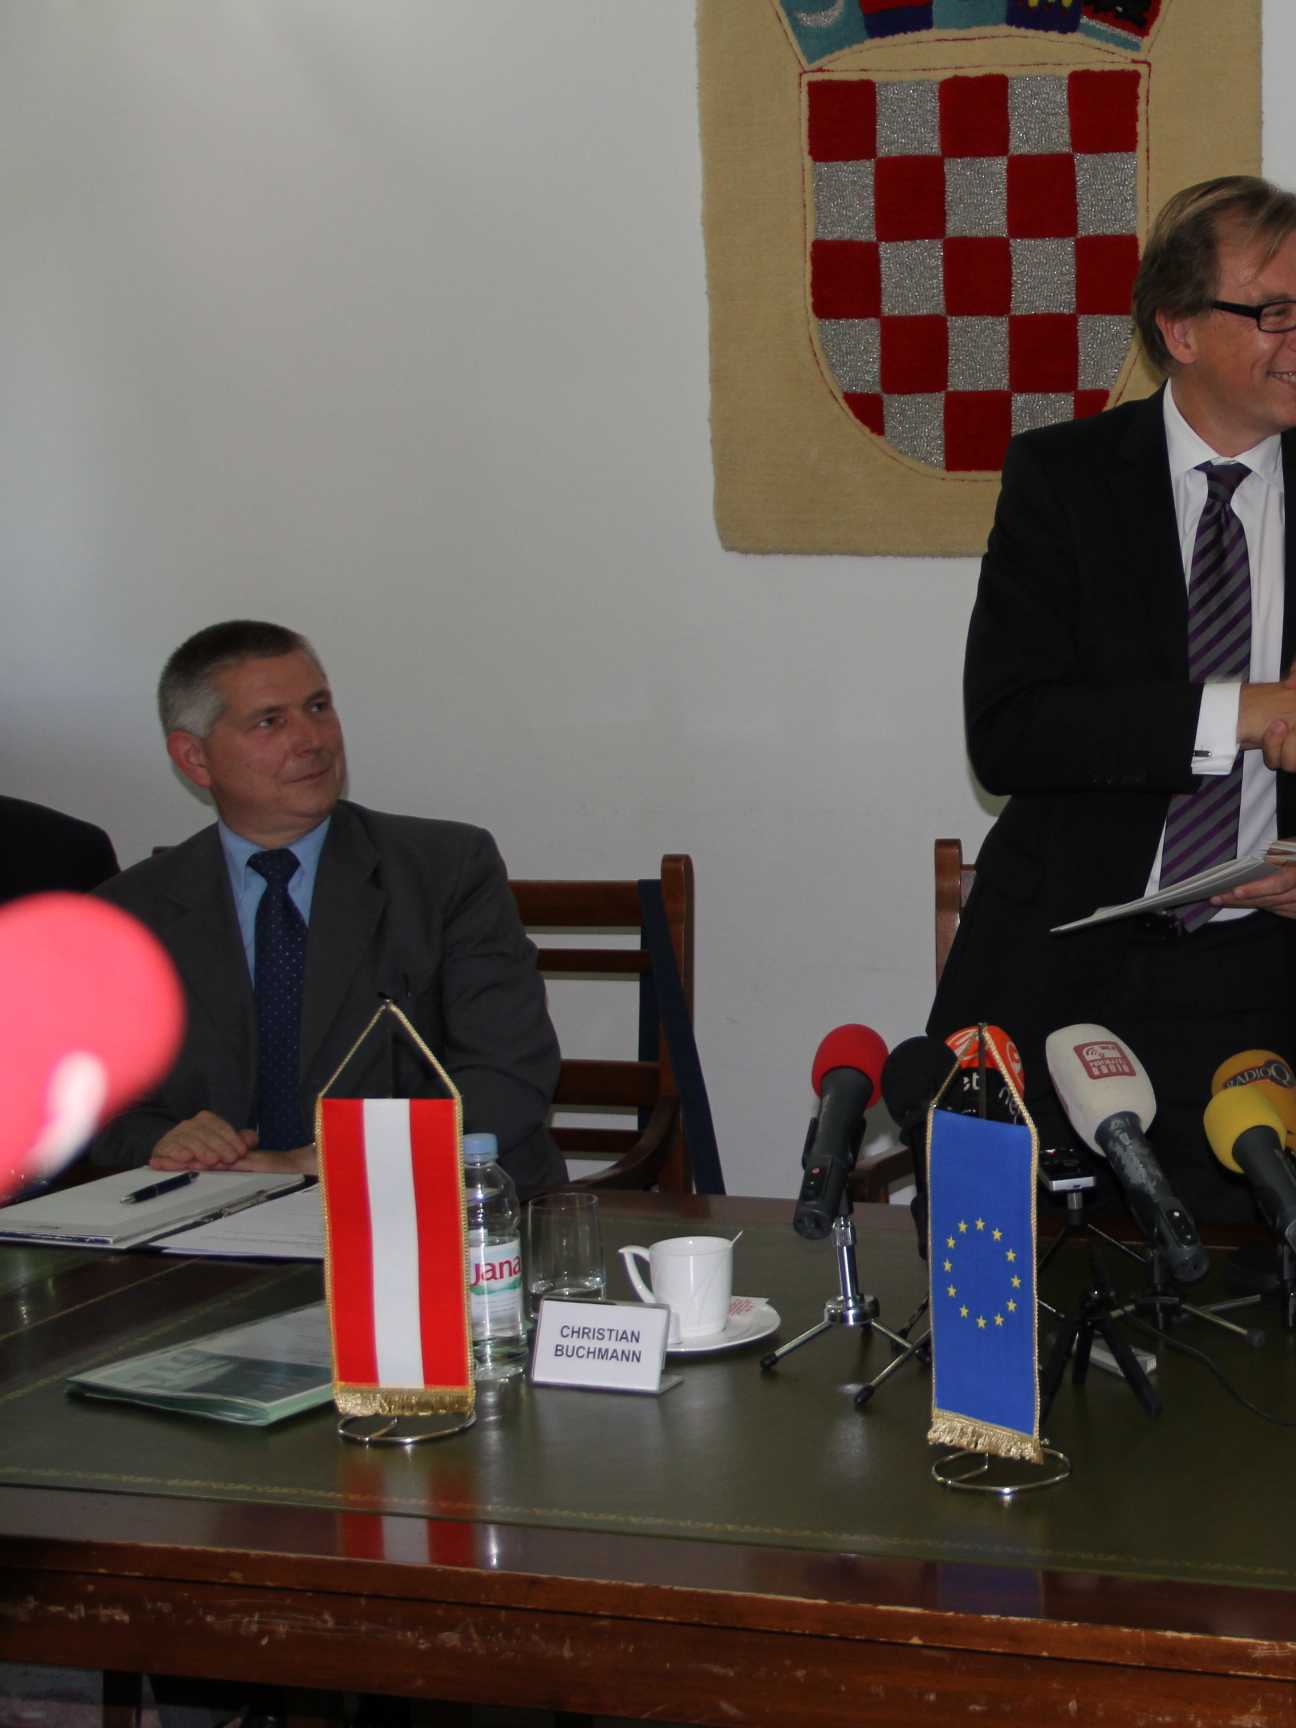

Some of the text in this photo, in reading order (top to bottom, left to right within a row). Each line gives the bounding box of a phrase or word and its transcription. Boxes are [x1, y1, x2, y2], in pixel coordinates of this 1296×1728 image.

[1091, 1063, 1130, 1075] RADIO
[560, 1325, 641, 1343] CHRISTIAN
[554, 1344, 642, 1363] BUCHMANN
